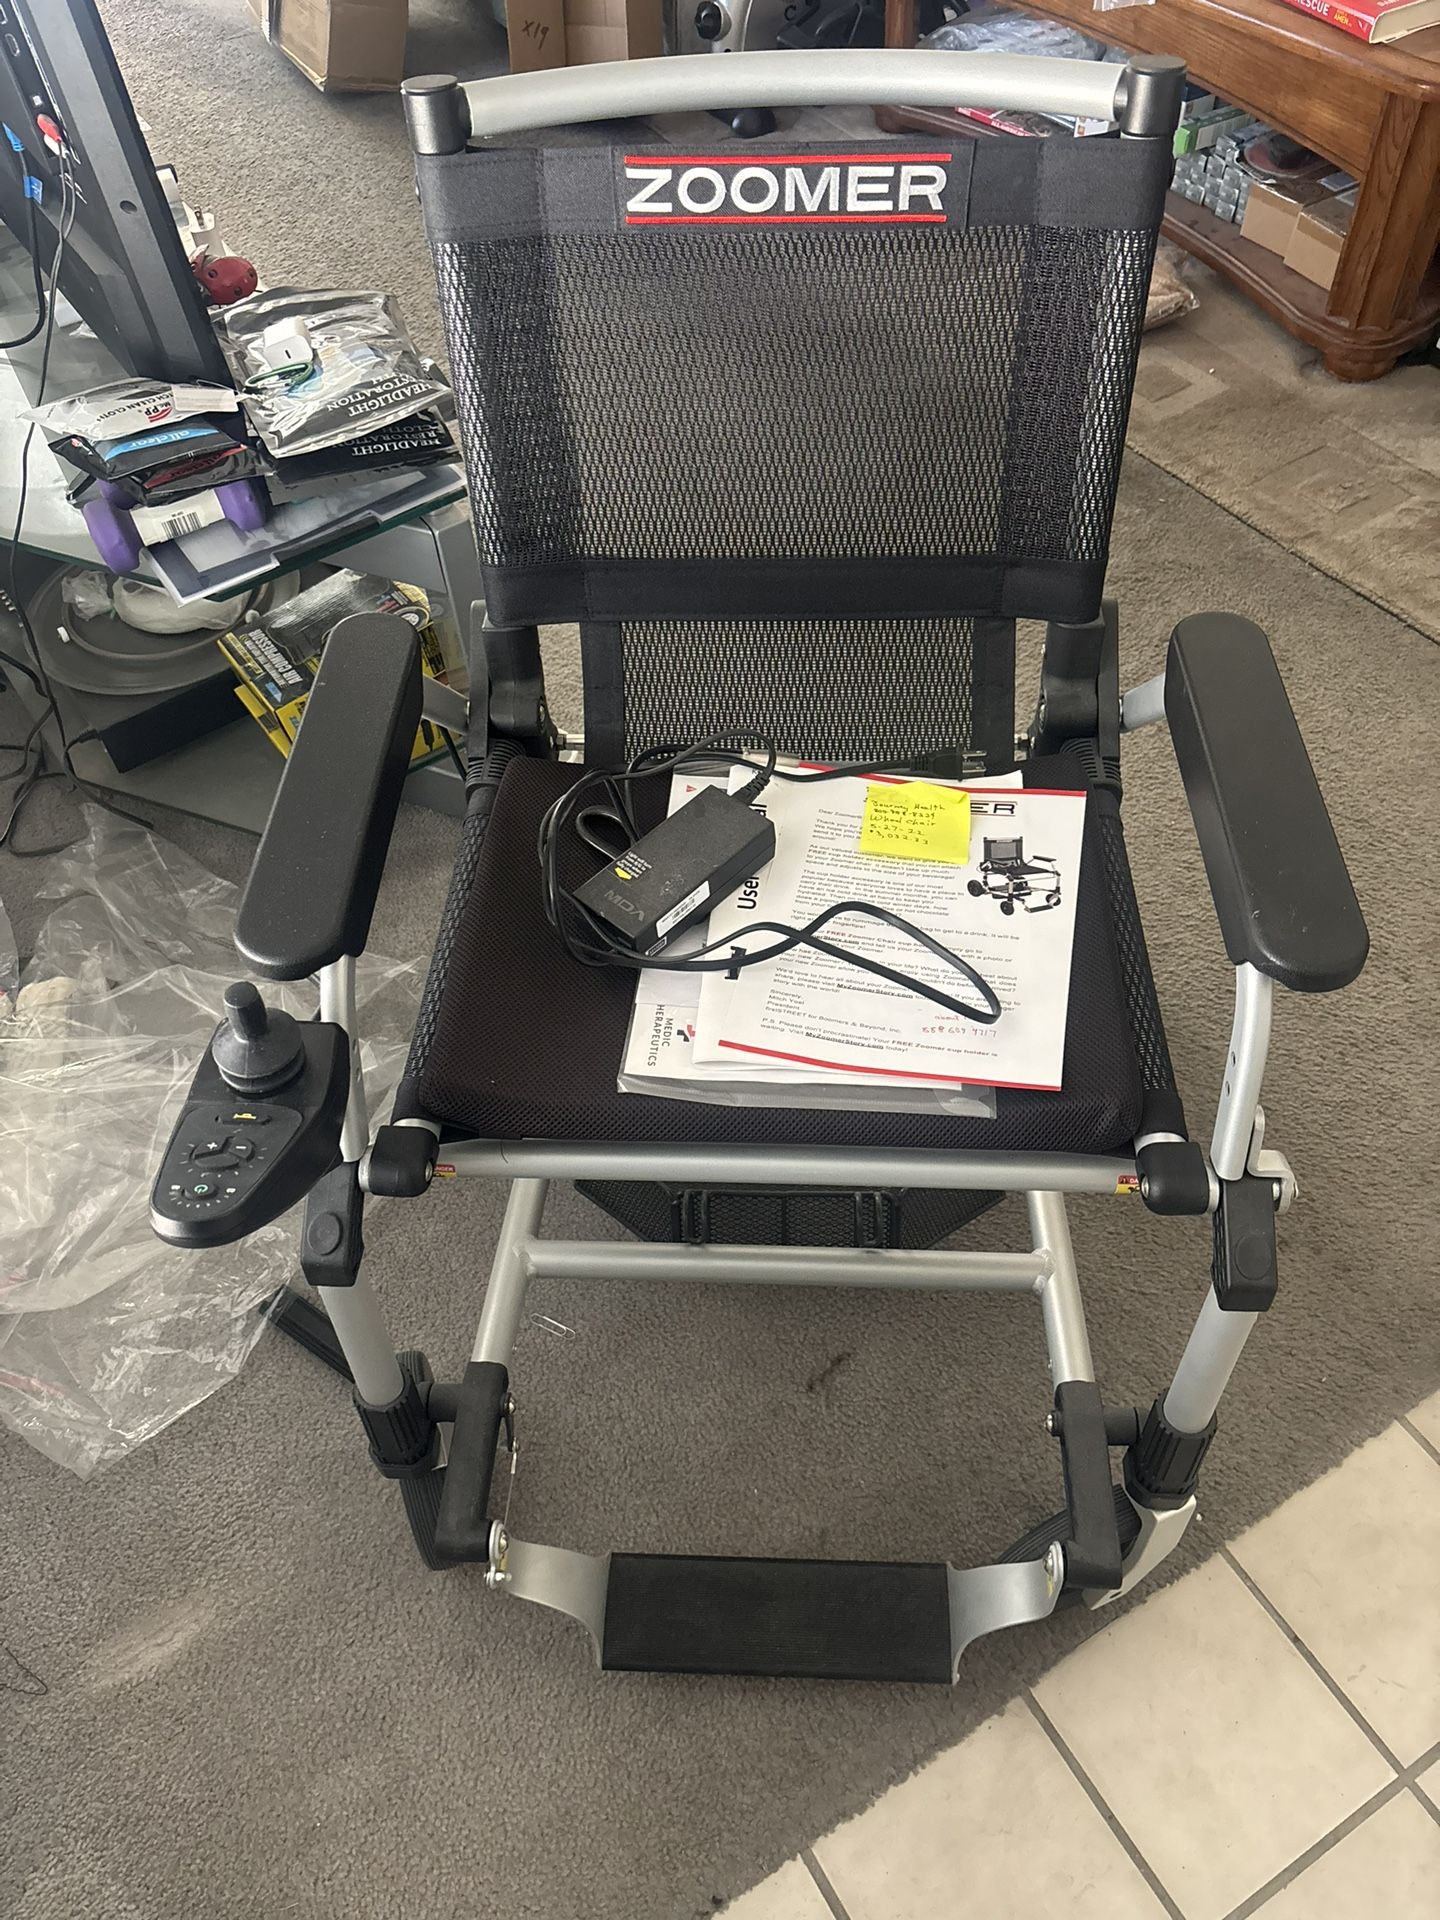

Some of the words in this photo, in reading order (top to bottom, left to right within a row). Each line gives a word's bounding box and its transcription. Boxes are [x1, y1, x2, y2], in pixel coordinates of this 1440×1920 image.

[625, 165, 947, 213] ZOOMER
[351, 437, 441, 457] HEADLIGHT
[648, 1004, 666, 1067] HERAPEUTICS
[662, 1017, 674, 1047] MEDIC
